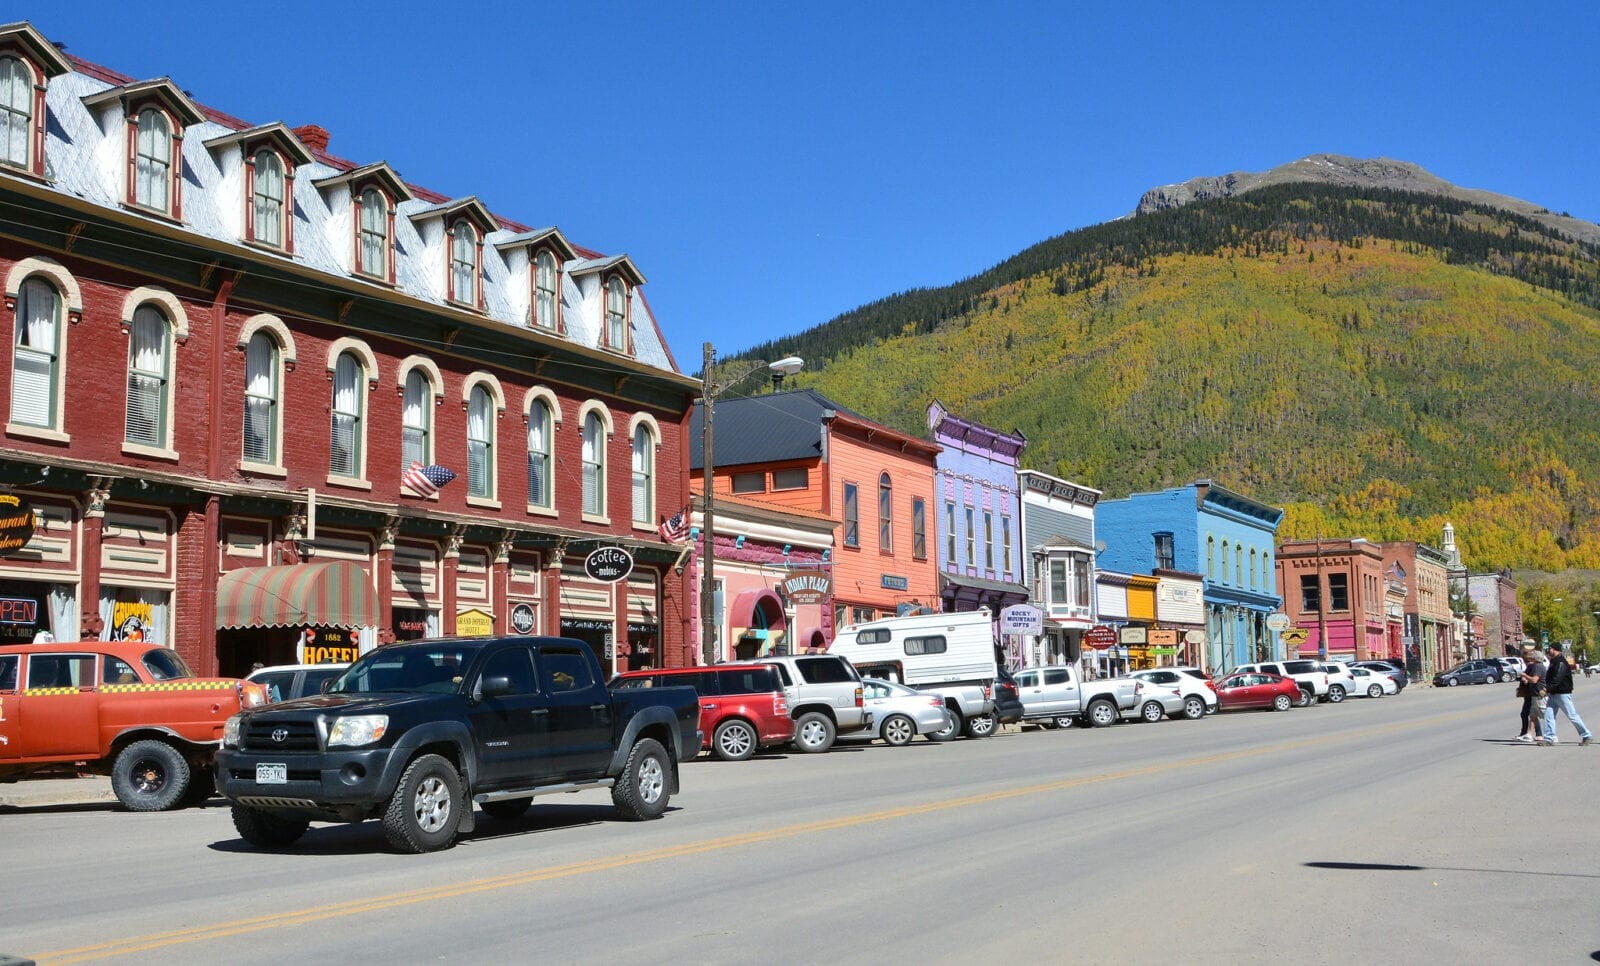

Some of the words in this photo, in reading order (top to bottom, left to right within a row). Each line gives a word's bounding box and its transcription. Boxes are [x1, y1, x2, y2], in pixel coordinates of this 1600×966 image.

[590, 550, 626, 566] coffee
[785, 575, 808, 594] INDIAN
[808, 575, 829, 593] PLAZA
[0, 600, 35, 621] PEN
[457, 617, 472, 626] GRAND
[472, 617, 490, 626] IMPERIAL
[464, 626, 480, 634] HOTEL
[325, 633, 342, 642] 1882
